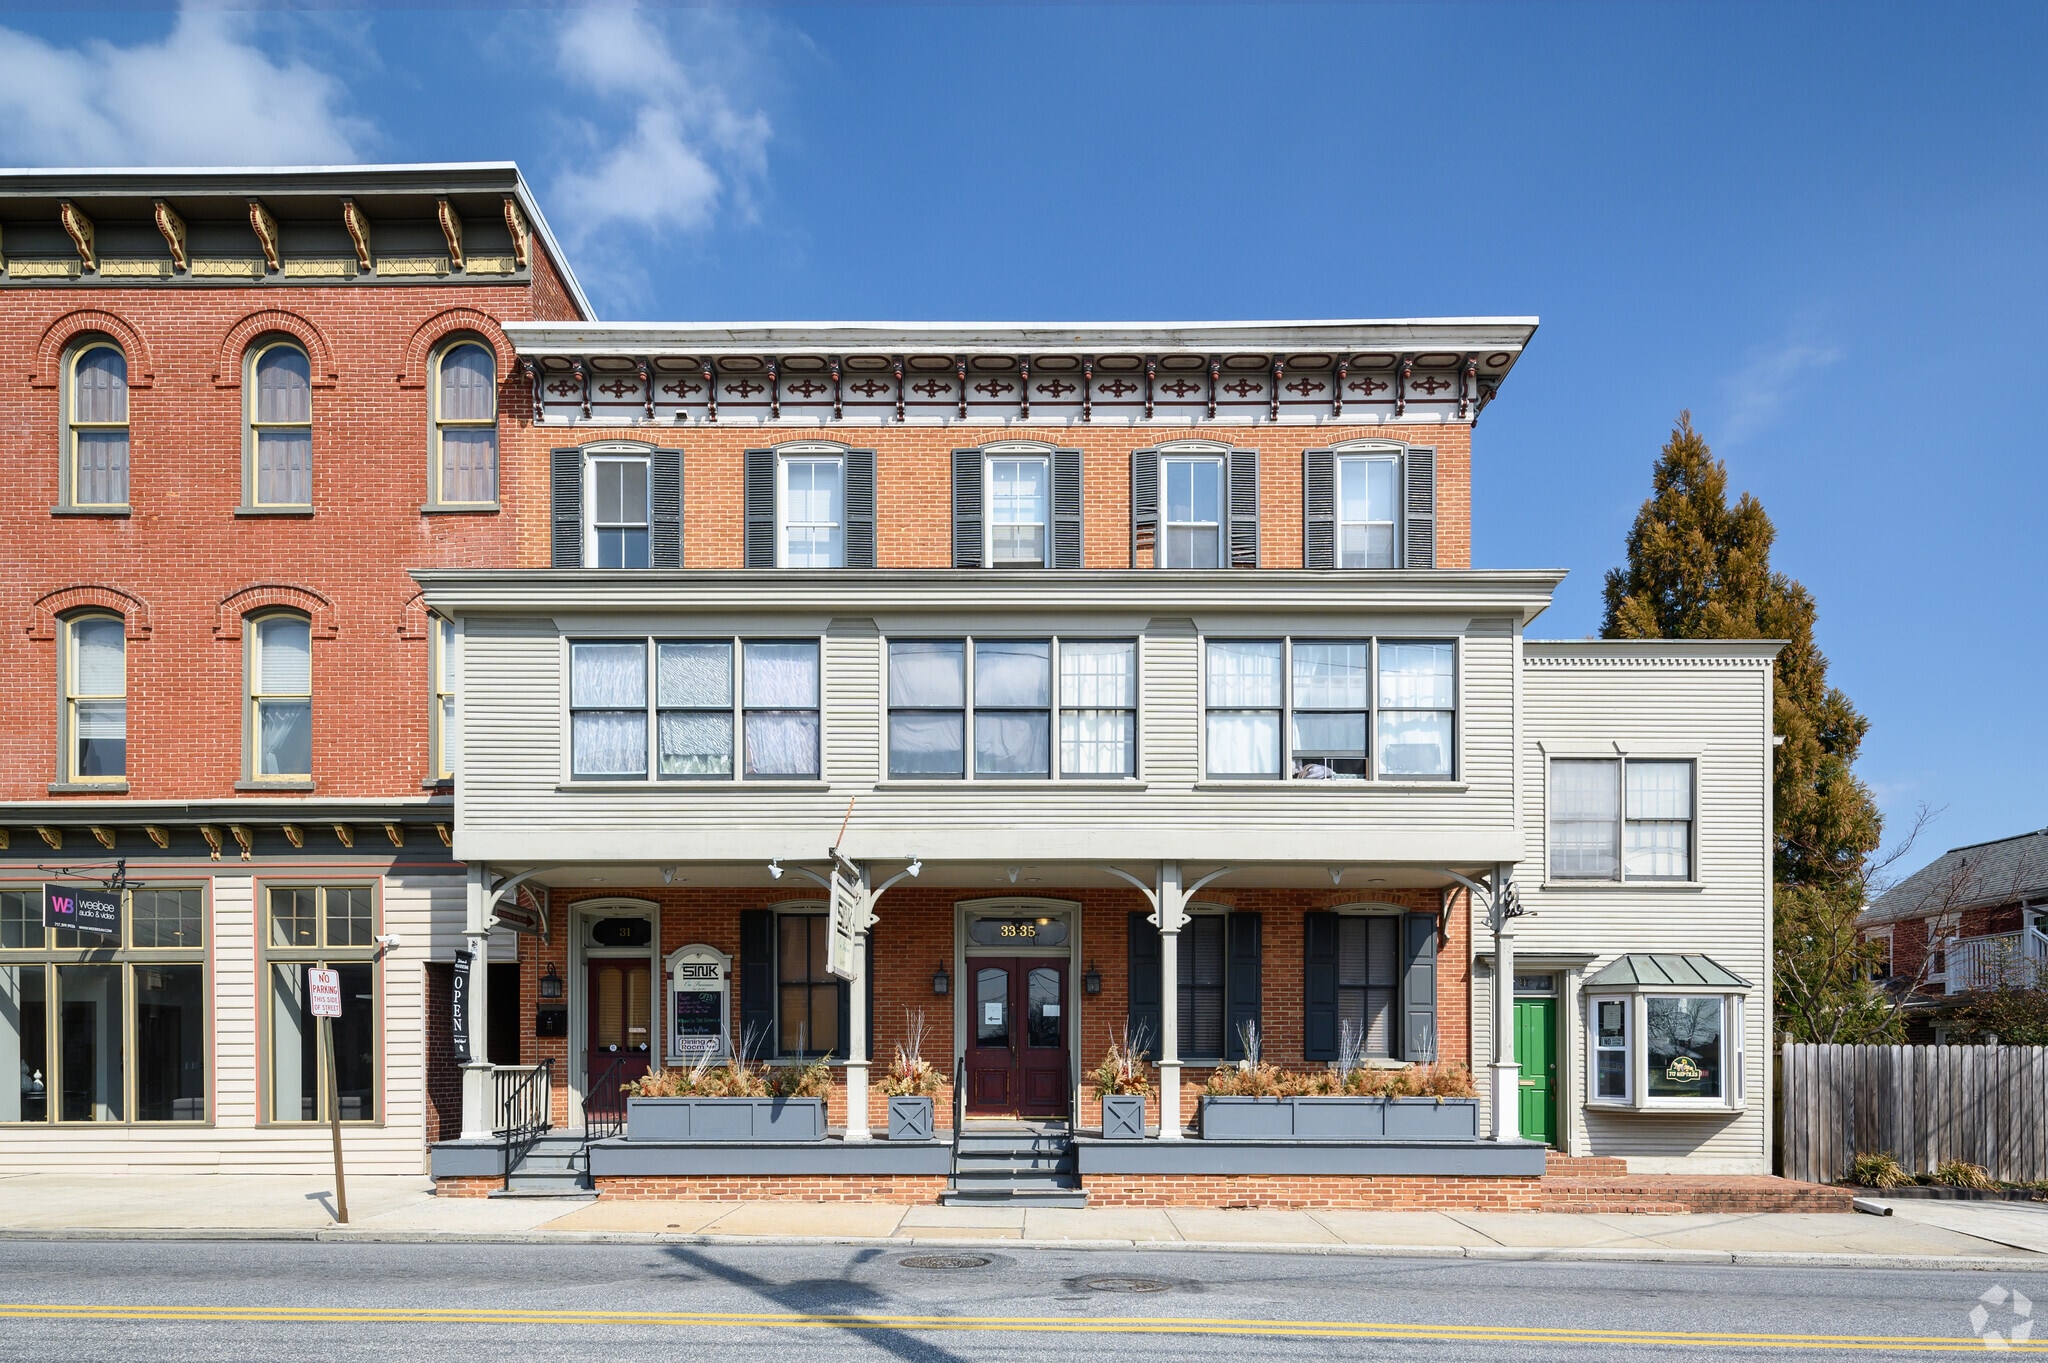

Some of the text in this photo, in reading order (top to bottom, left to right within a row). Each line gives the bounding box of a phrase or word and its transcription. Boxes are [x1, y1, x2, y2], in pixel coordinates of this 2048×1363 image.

[79, 900, 115, 913] weebee
[79, 910, 95, 918] audio
[95, 911, 100, 919] &
[619, 927, 631, 937] 31
[1001, 925, 1036, 937] 33-35
[683, 965, 719, 977] SINK
[318, 974, 330, 983] NO
[312, 984, 338, 995] PARKING
[313, 995, 326, 1003] THIS
[453, 976, 463, 1031] OPEN
[322, 1004, 339, 1012] STREET
